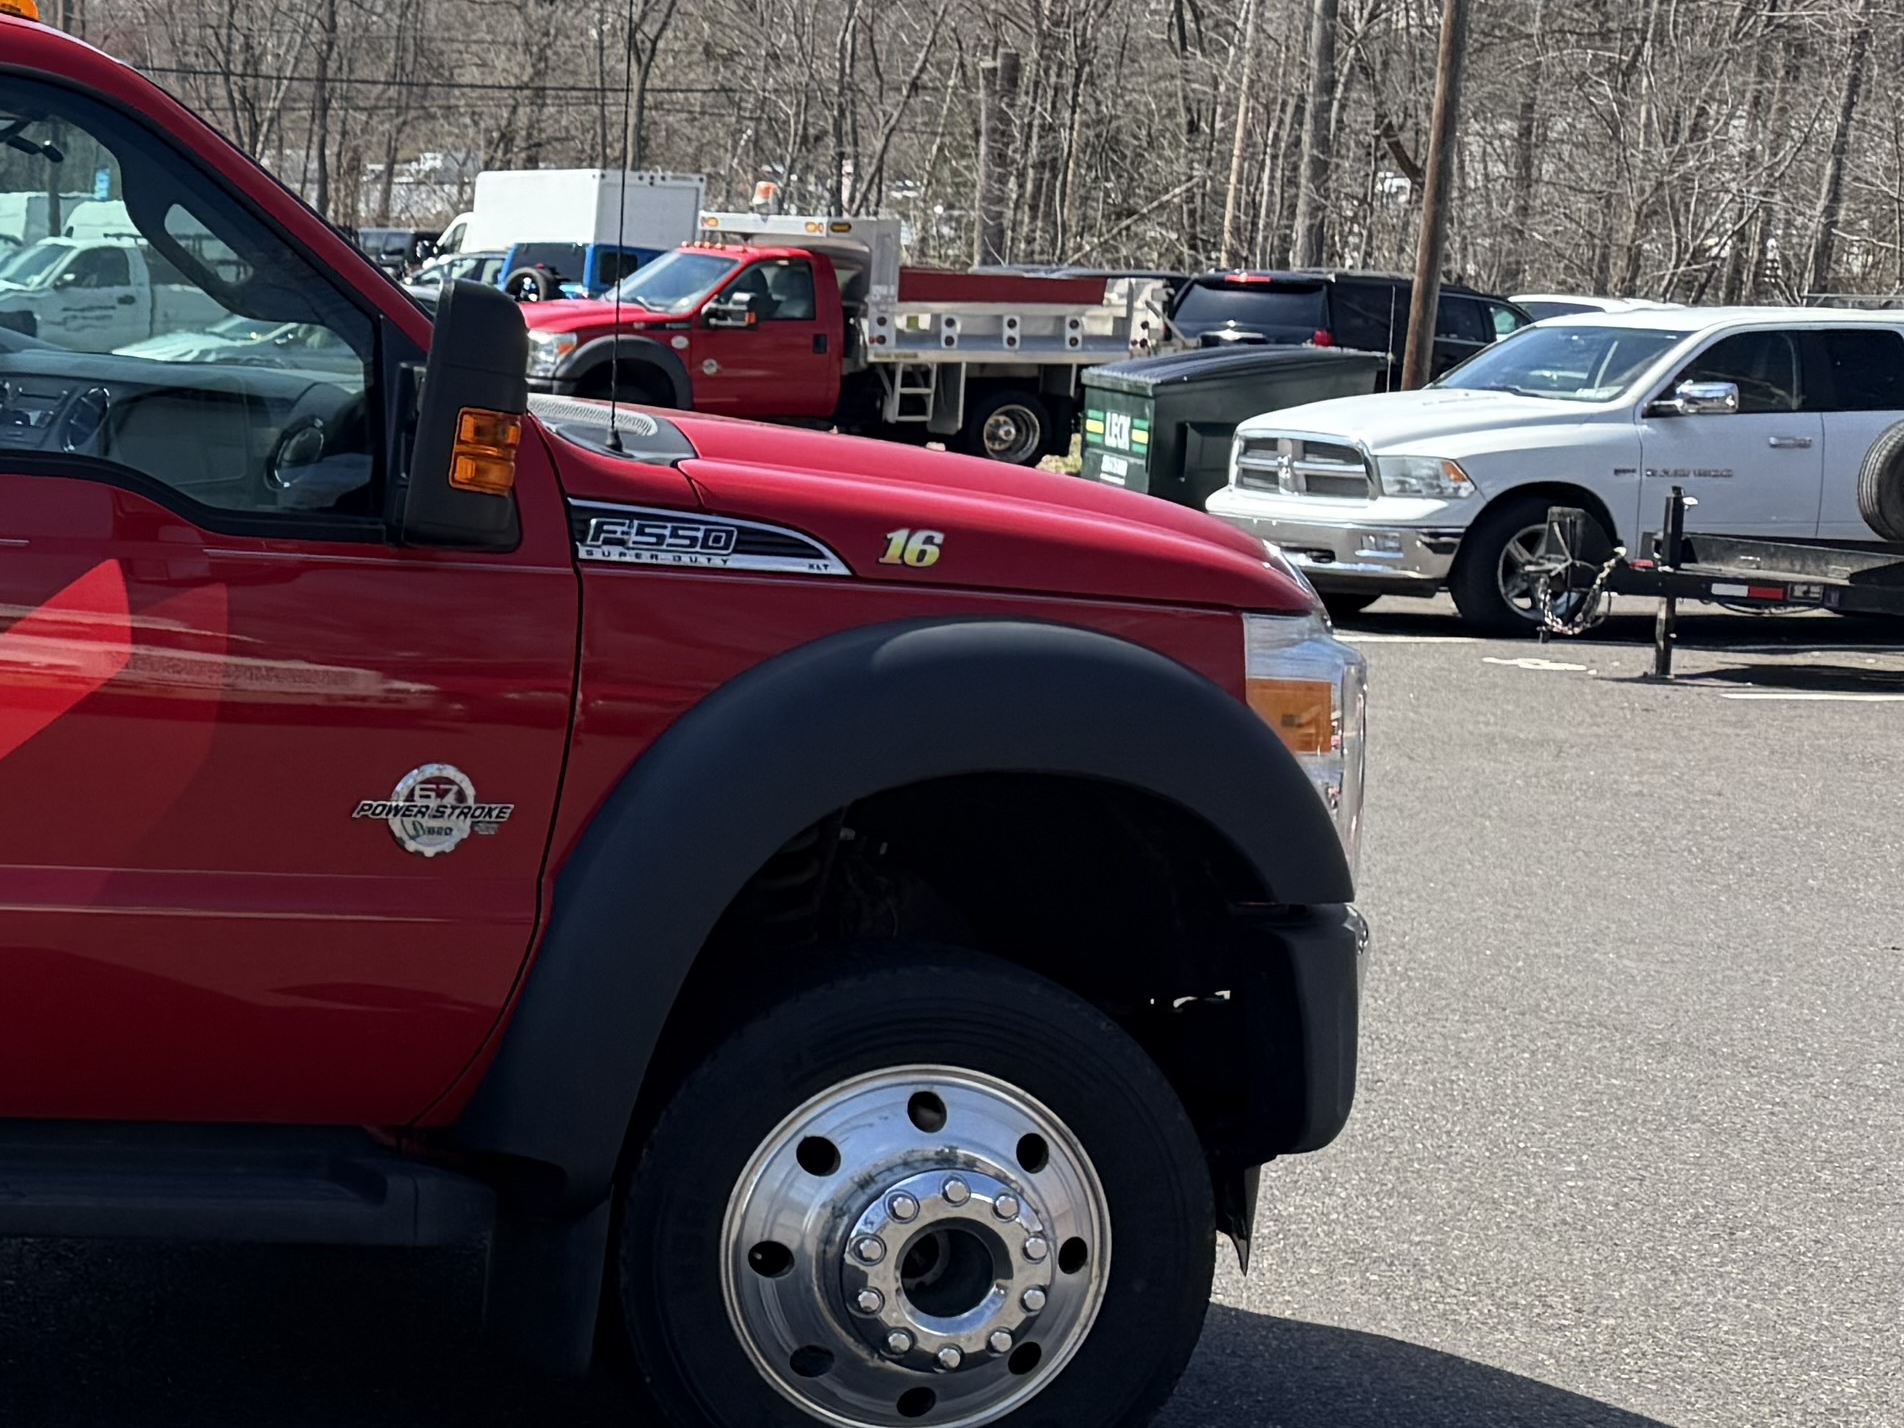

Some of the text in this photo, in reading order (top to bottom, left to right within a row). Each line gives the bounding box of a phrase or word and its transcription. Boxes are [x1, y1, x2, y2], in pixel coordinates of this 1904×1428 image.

[587, 518, 738, 555] F-550
[878, 529, 945, 569] 16
[585, 547, 730, 566] SUPER DUTY
[355, 801, 512, 820] POWER STROKE
